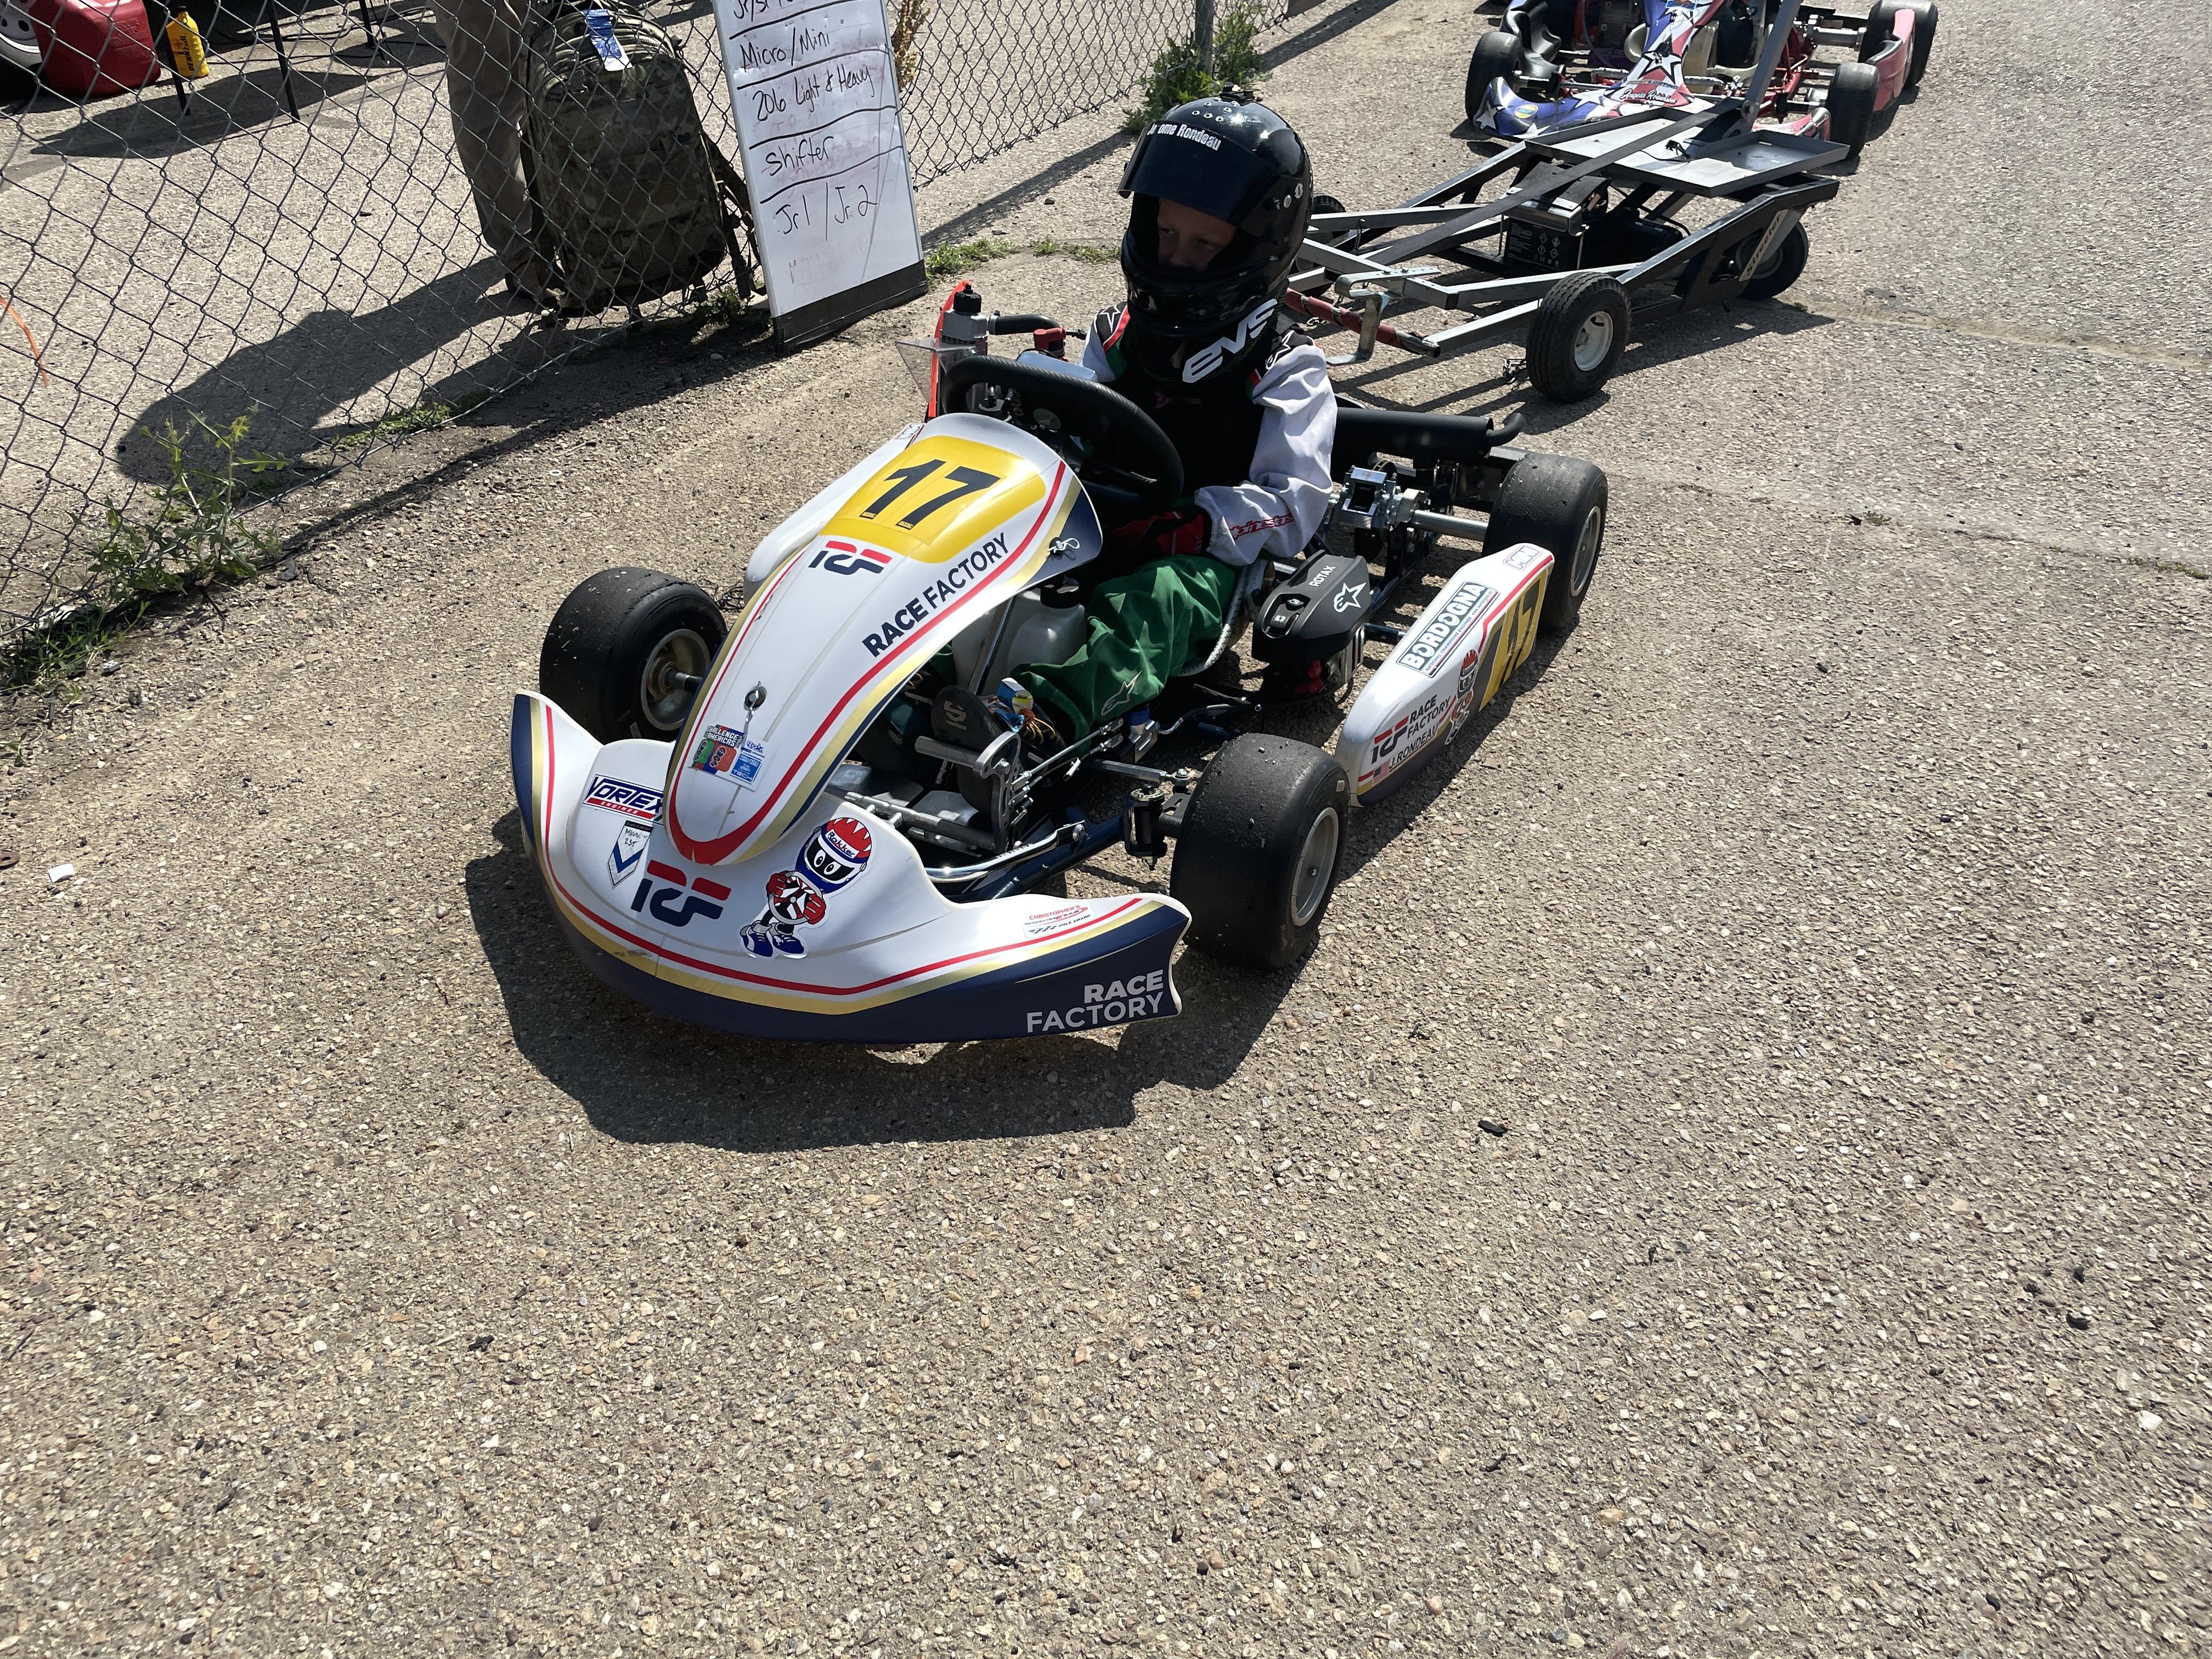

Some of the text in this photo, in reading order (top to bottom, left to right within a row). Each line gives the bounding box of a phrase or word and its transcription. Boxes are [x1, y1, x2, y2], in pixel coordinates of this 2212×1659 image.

[753, 90, 786, 121] 206
[794, 74, 820, 113] Light
[837, 63, 875, 98] Heavy
[1176, 123, 1222, 151] Rondeau
[859, 459, 1001, 531] 17
[1308, 565, 1336, 587] ROTAX
[861, 532, 1009, 658] RACE FACTORY
[1400, 584, 1486, 669] BORDOGNA
[1425, 616, 1472, 672] NATIONAL CHAMPIONS ENGINES
[1407, 695, 1452, 740] FACTORY
[1409, 694, 1437, 725] RACE
[708, 725, 740, 741] CHALLENGE
[708, 732, 736, 747] AMERICAS
[585, 776, 664, 814] VORTEX
[600, 801, 639, 814] ENGINES
[1029, 905, 1080, 921] CHRISTOPHER'S
[1073, 915, 1091, 923] AWARD
[1084, 969, 1164, 1004] RACE
[1026, 991, 1164, 1032] FACTORY
